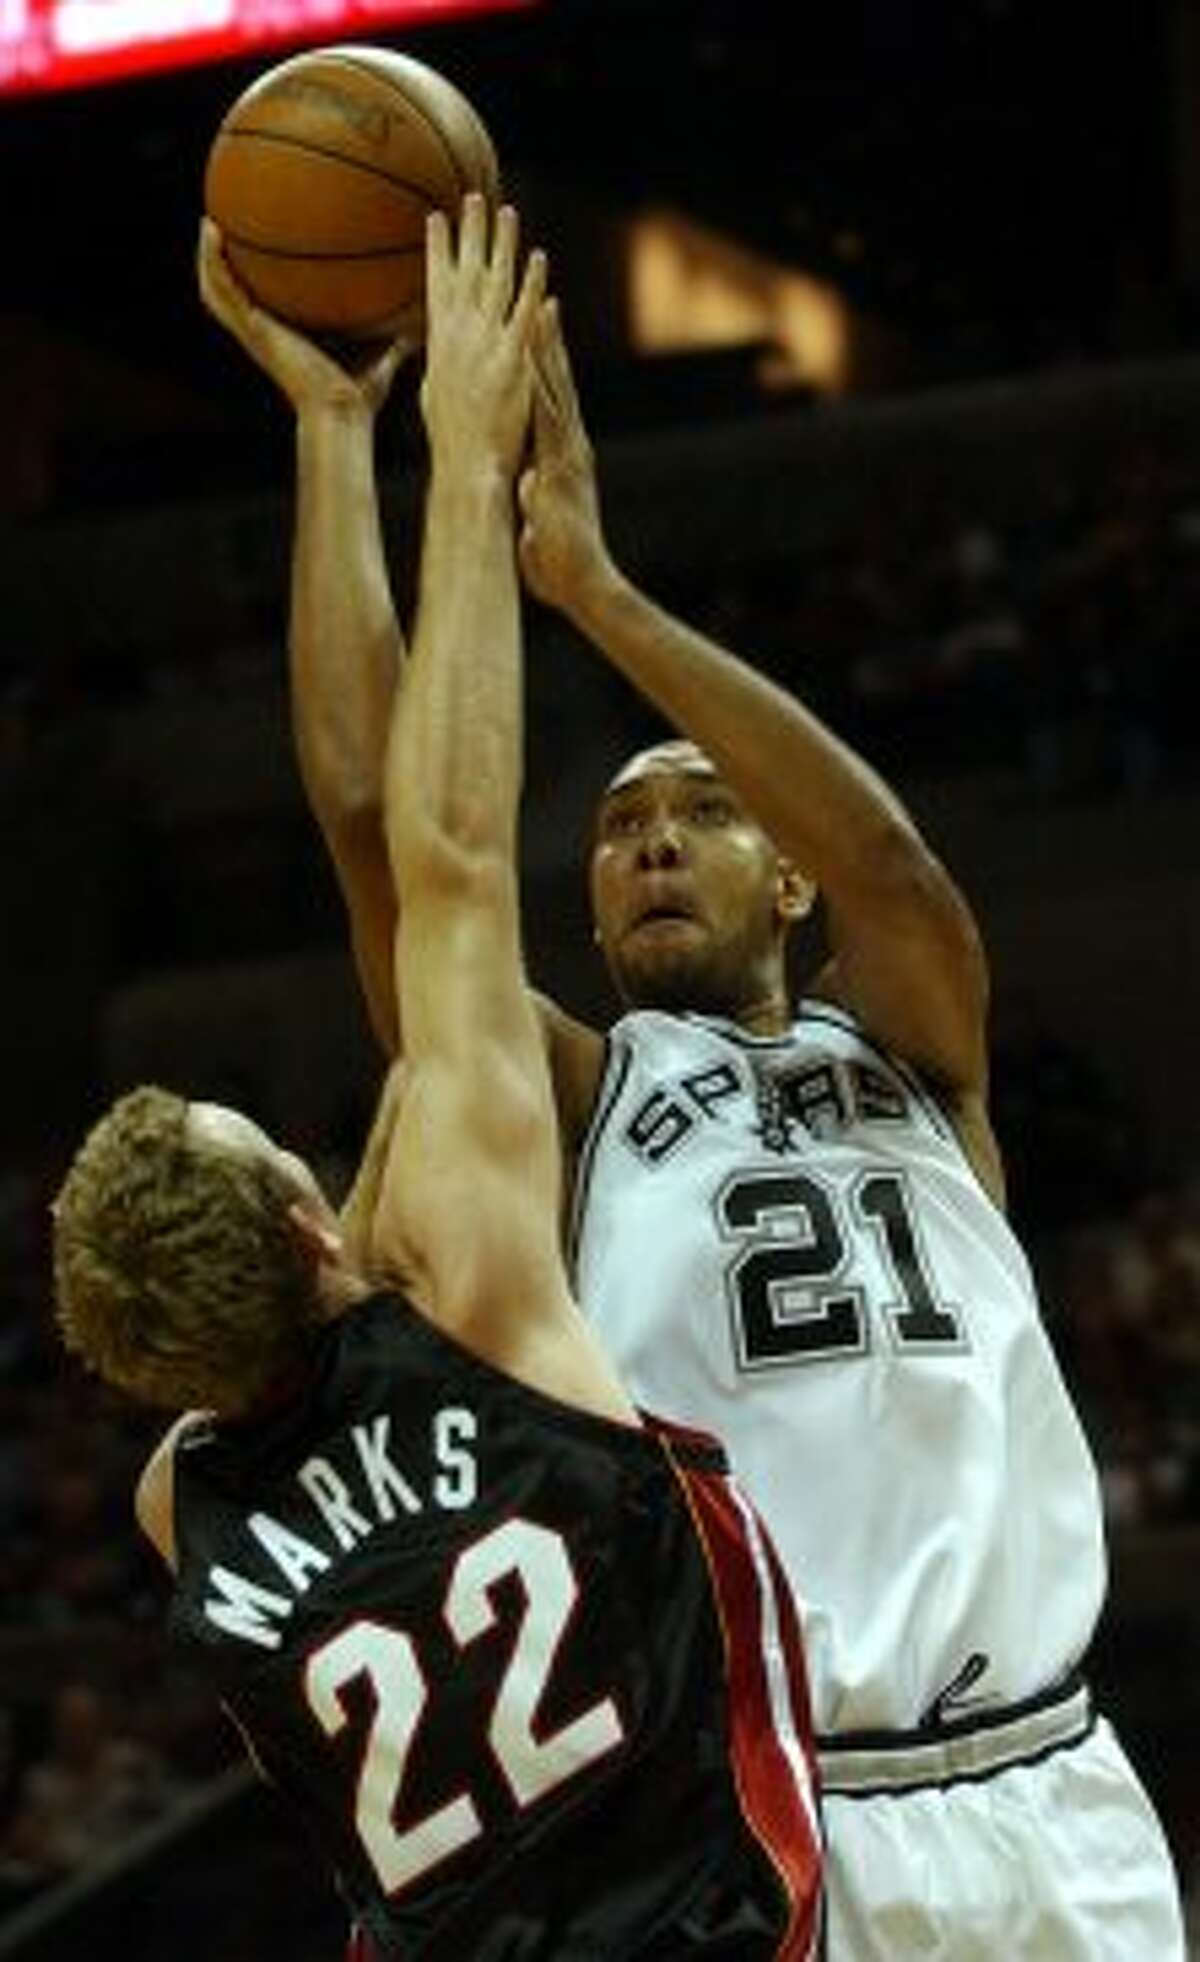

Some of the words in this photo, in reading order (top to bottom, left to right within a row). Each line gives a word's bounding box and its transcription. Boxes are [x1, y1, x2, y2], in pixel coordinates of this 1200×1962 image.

[716, 1169, 971, 1372] 21
[204, 1407, 478, 1650] MARKS
[305, 1517, 624, 1895] 22
